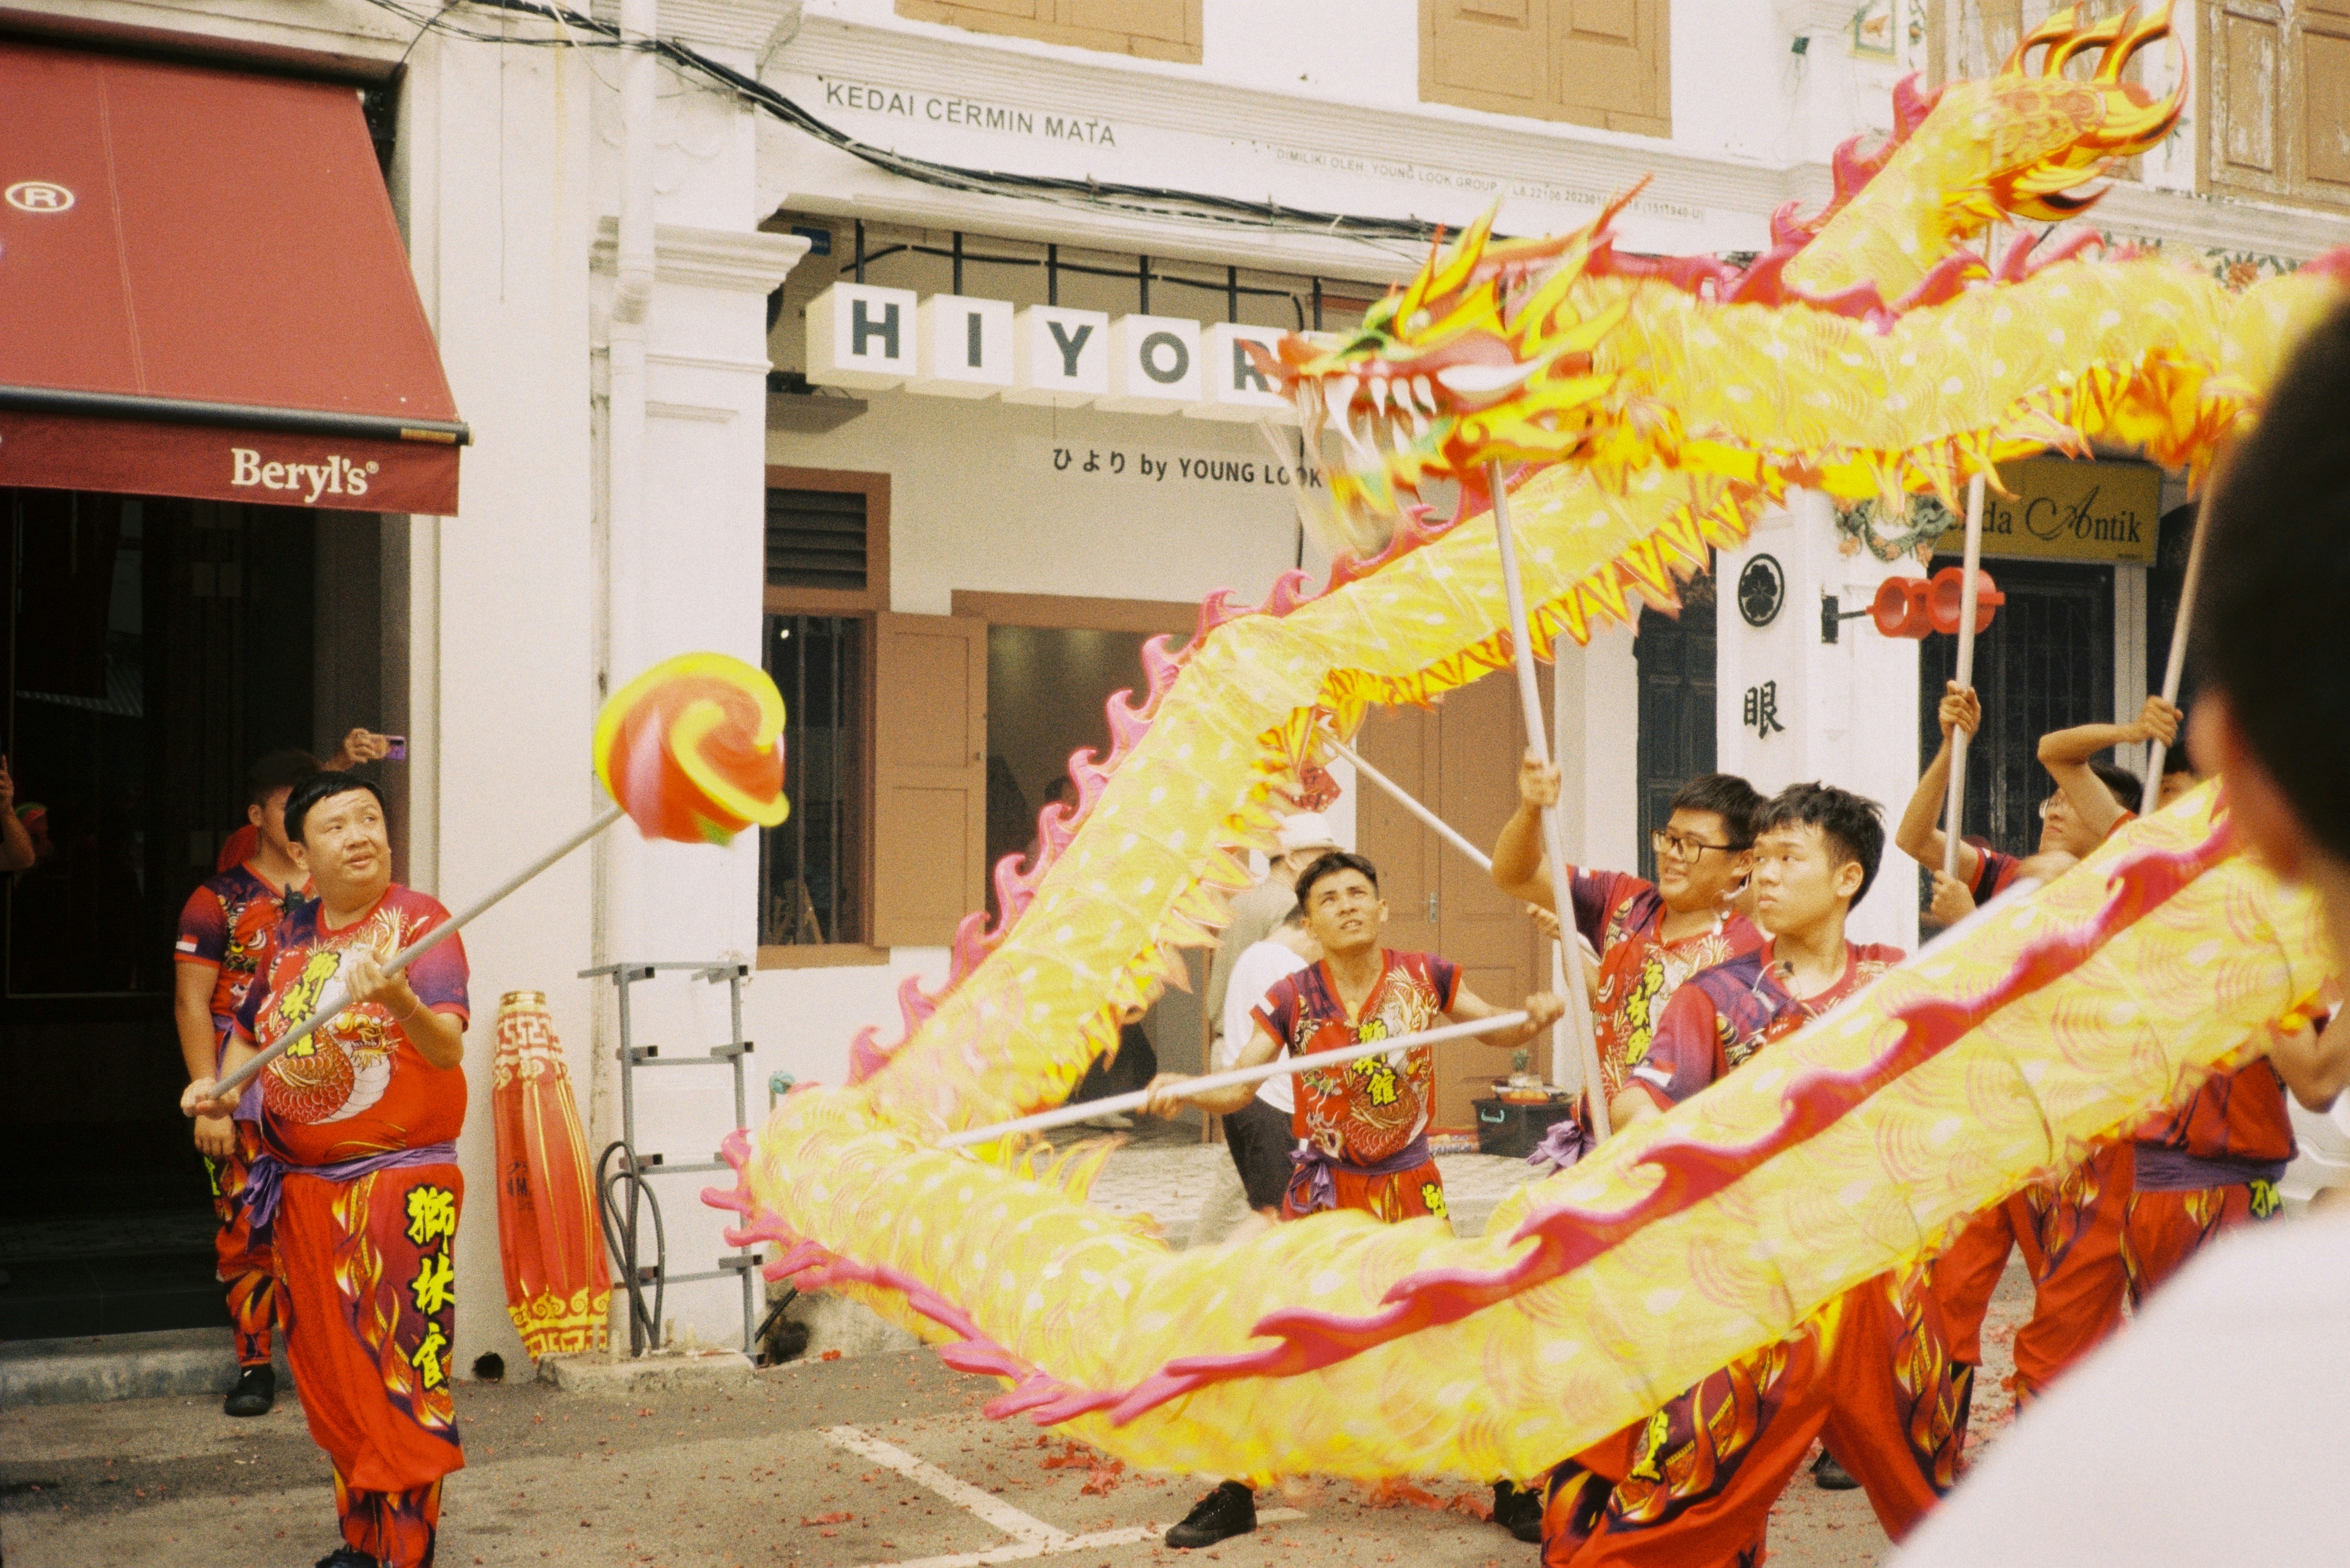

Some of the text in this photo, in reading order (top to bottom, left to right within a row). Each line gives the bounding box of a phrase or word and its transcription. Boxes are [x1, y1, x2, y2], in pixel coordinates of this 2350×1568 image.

[826, 81, 1116, 147] KEDAI CERMIN MATA
[1276, 148, 1327, 166] DIMILIKI
[1330, 157, 1364, 172] OLEH
[1372, 163, 1414, 179] YOUNG
[1419, 171, 1451, 186] LOOK
[1456, 175, 1497, 191] GROUP
[1053, 448, 1126, 474] ひより
[1141, 454, 1167, 481] by
[1179, 458, 1255, 483] YOUNG
[1743, 680, 1785, 740] 眼
